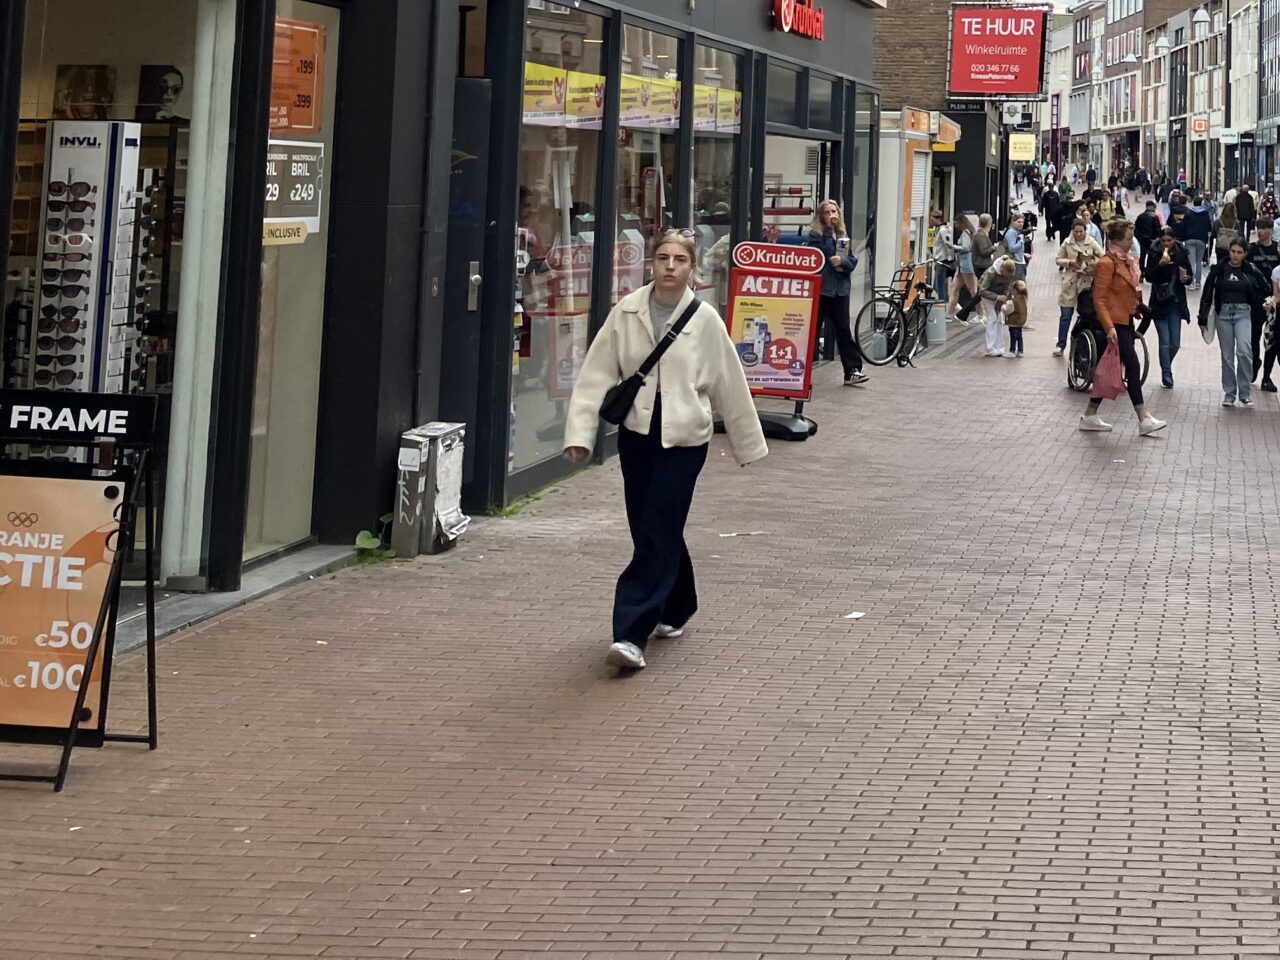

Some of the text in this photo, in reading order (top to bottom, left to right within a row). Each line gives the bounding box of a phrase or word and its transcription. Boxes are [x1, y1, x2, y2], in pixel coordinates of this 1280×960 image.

[961, 17, 1035, 36] TE HUUR
[965, 43, 1028, 56] Winkelruimte
[970, 63, 1020, 73] 020 346 77 66
[291, 162, 310, 177] BRIL
[290, 183, 315, 201] €249
[262, 227, 302, 240] -INCLUSIVE
[756, 248, 818, 267] Kruidvat
[741, 274, 810, 297] ACTIE!
[769, 345, 793, 360] 1+1
[10, 405, 129, 434] FRAME
[34, 620, 95, 650] €50
